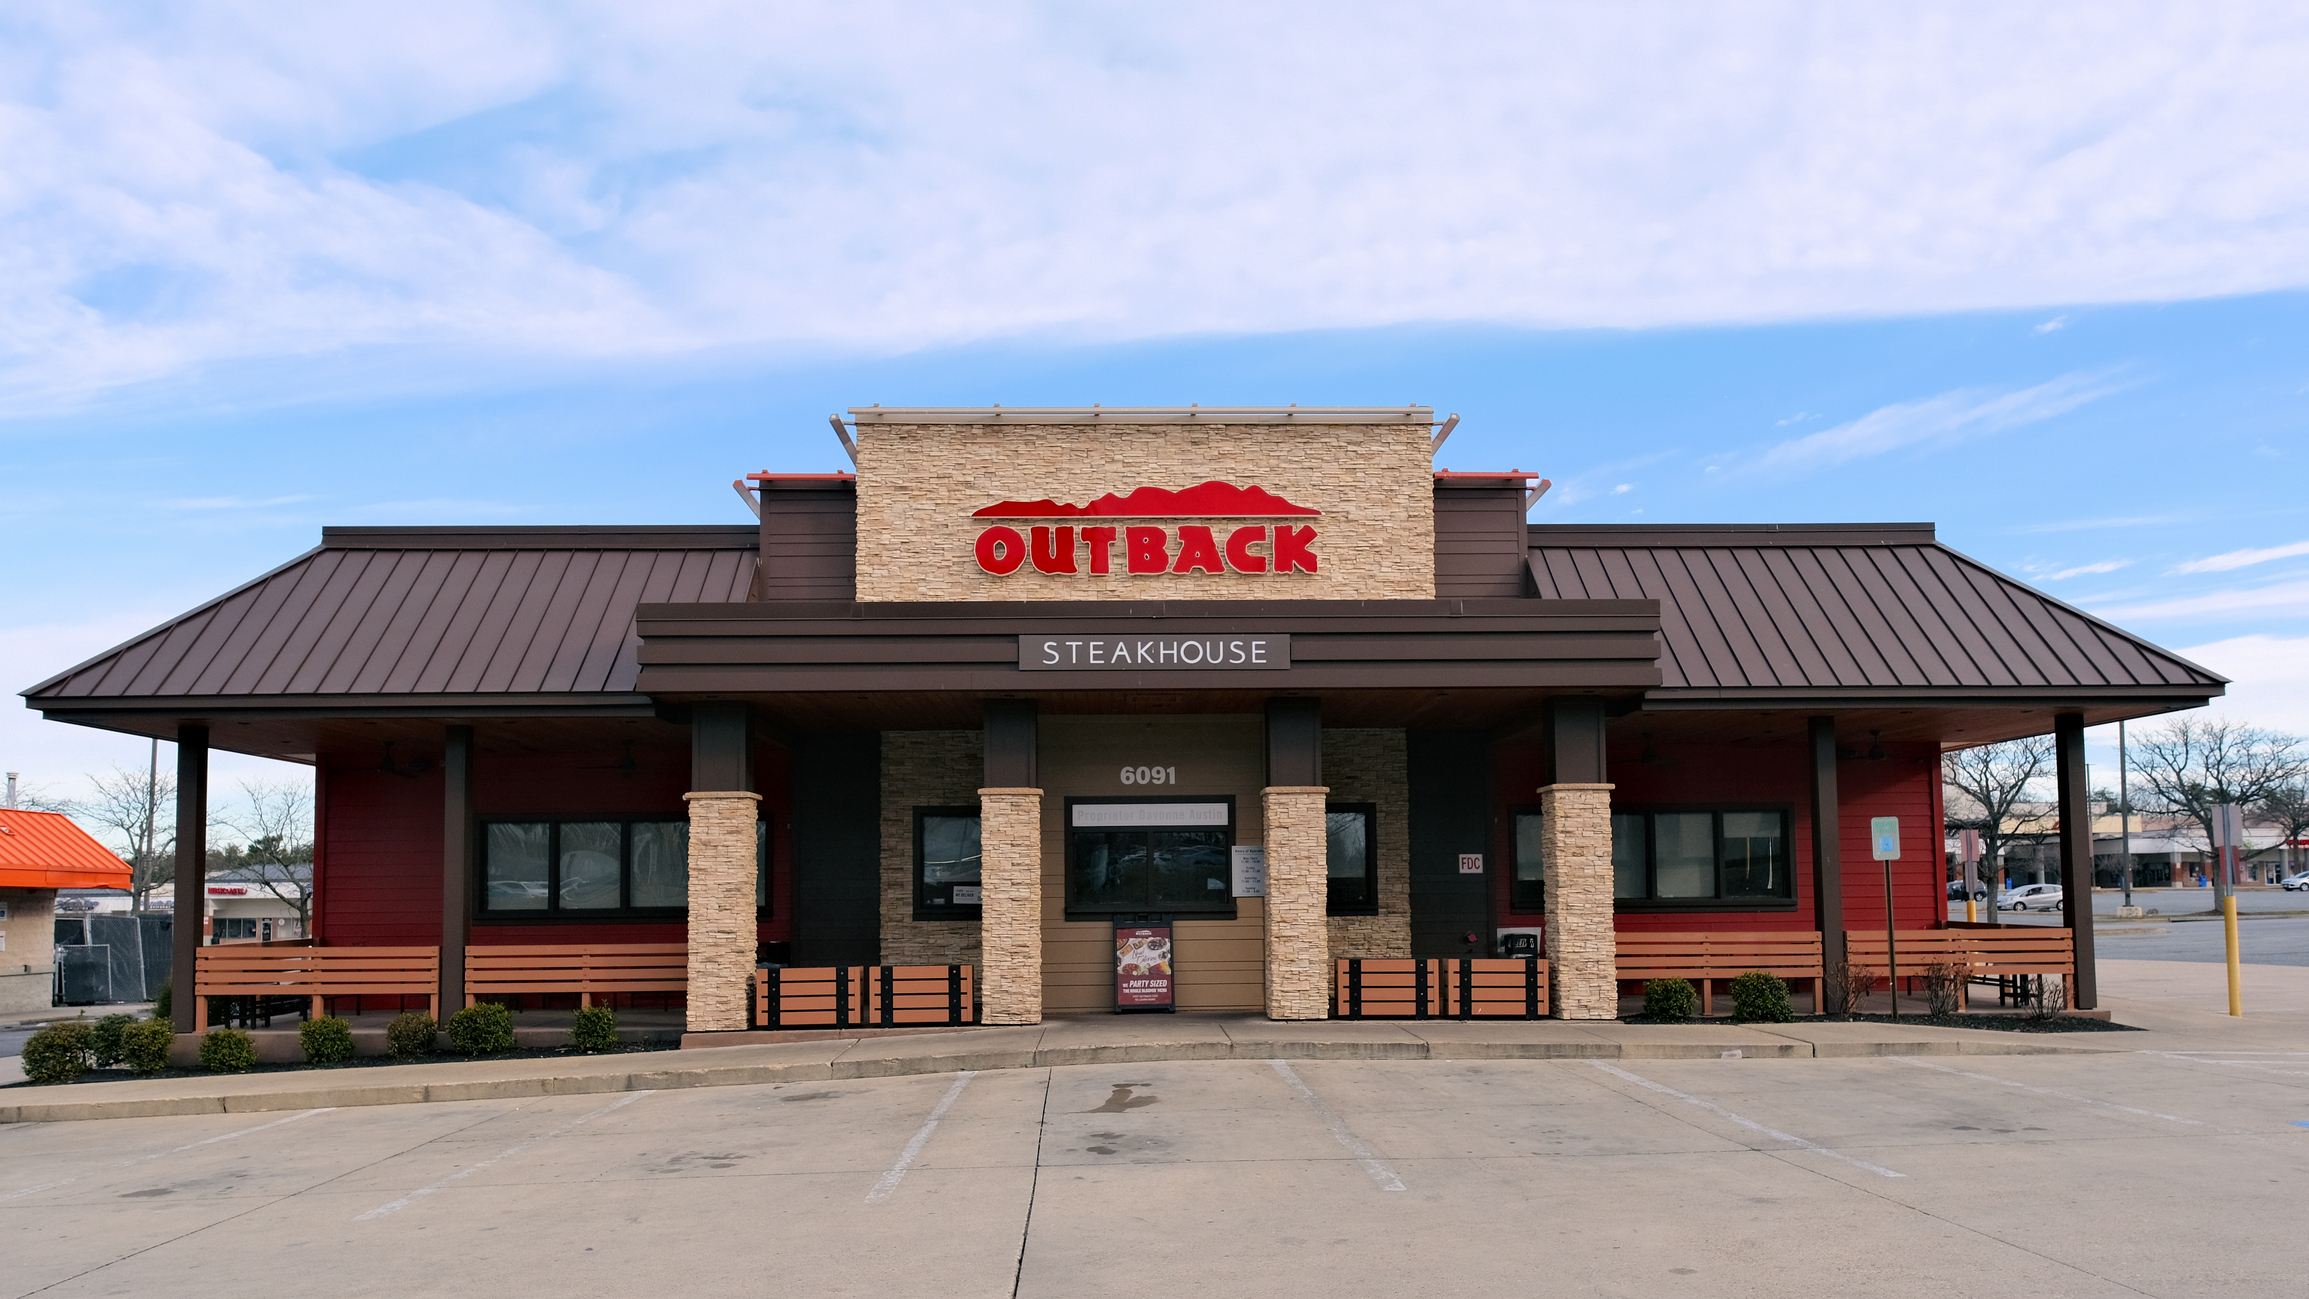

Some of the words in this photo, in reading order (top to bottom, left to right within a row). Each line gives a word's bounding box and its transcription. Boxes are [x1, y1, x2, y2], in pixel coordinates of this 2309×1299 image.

[974, 524, 1319, 576] OUTBACK
[1042, 640, 1268, 664] STEAKHOUSE
[1120, 766, 1176, 785] 6091
[1077, 809, 1135, 821] Proprietor
[1190, 808, 1223, 820] Austin
[1461, 857, 1480, 870] FDC
